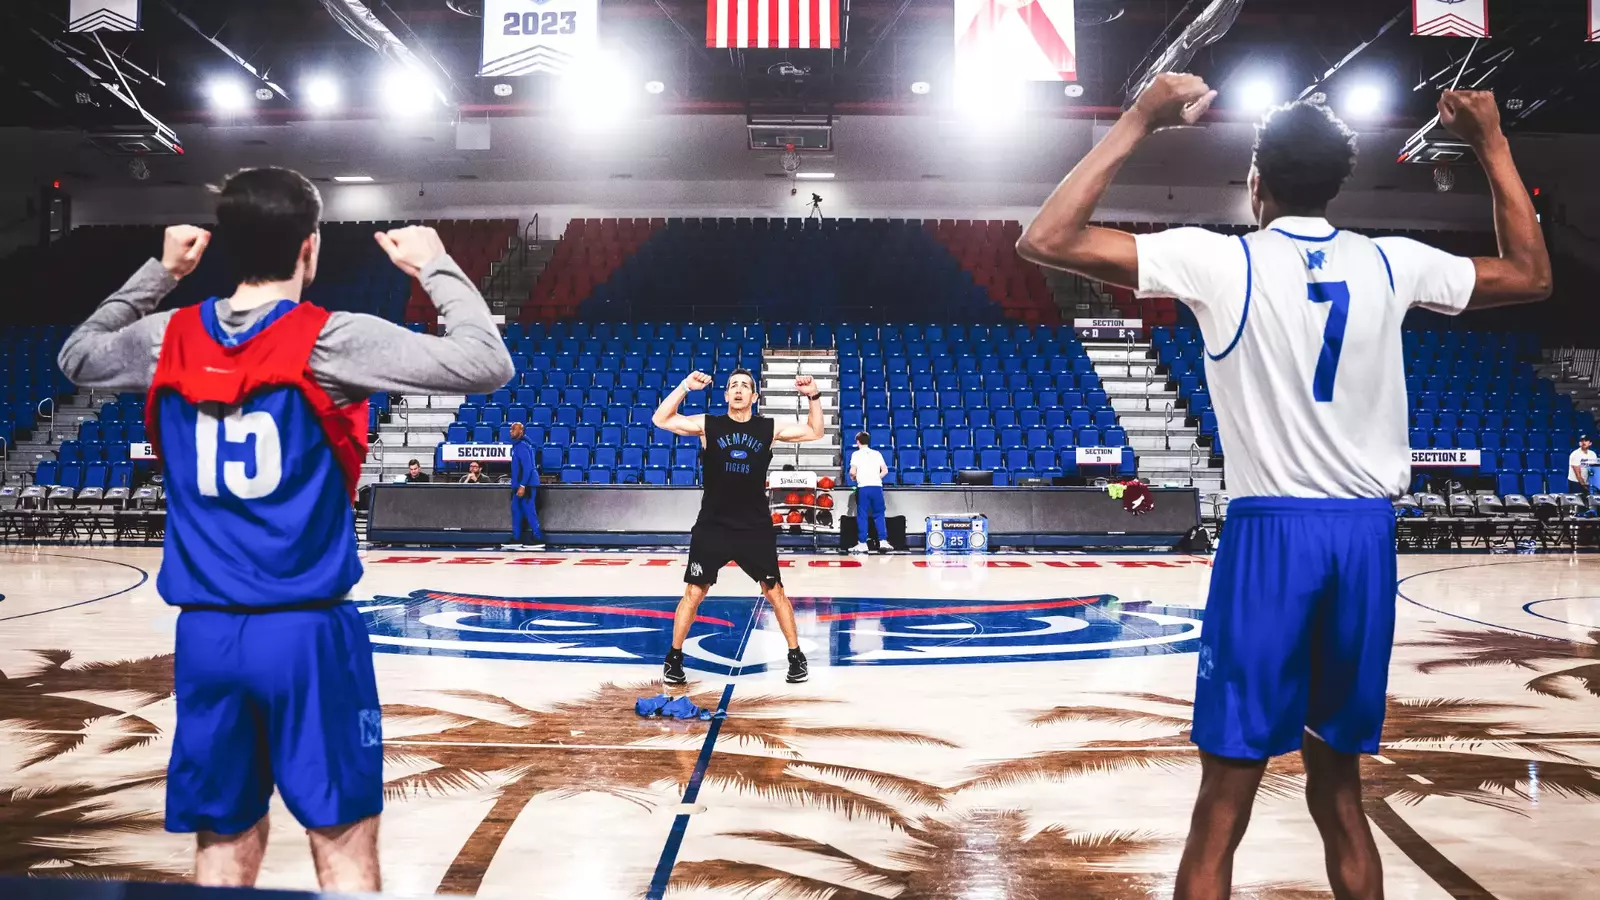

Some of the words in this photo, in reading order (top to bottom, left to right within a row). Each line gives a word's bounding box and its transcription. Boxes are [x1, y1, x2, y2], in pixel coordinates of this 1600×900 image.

[503, 11, 576, 35] 2023
[1092, 329, 1099, 338] D
[1118, 329, 1126, 338] E
[1306, 280, 1350, 402] 7
[716, 432, 763, 453] MEMPHIS
[195, 401, 282, 500] 15
[458, 447, 506, 457] SECTION
[1411, 452, 1457, 462] SECTION
[1459, 452, 1467, 462] E
[725, 462, 750, 474] TIGERS
[950, 536, 964, 546] 25
